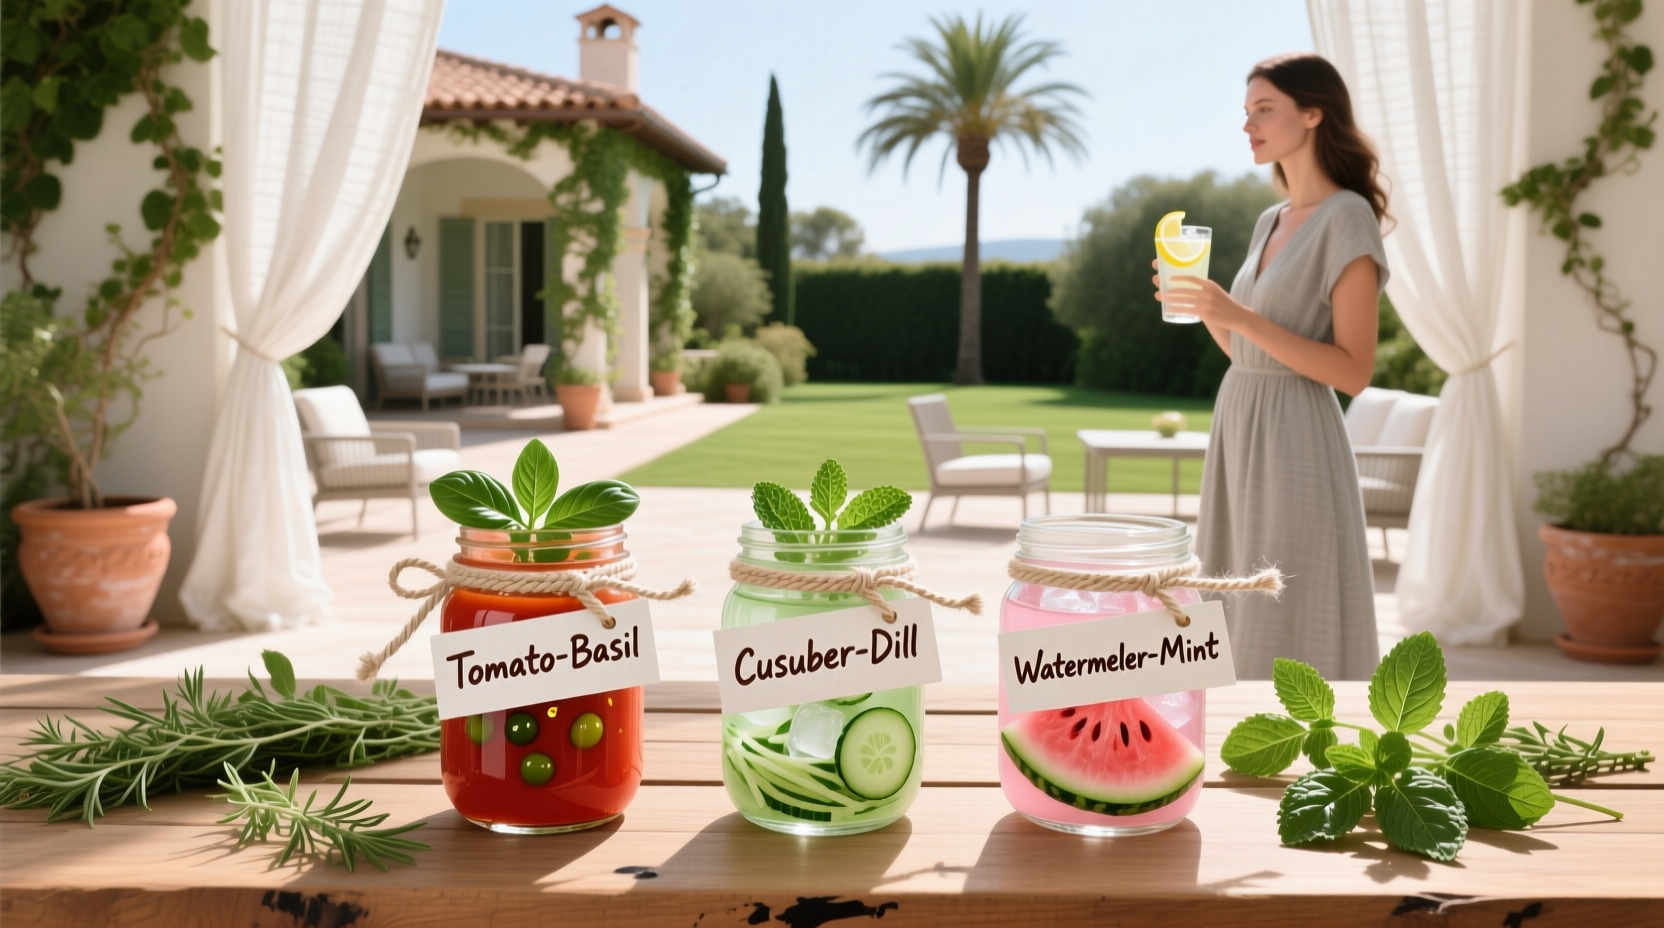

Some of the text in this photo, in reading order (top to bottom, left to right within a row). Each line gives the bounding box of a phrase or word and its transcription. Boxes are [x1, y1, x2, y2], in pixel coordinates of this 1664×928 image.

[446, 626, 639, 689] Tomato-Basil
[734, 623, 918, 686] Cusuber-Dill
[1013, 631, 1220, 685] Watermeler-Mint
